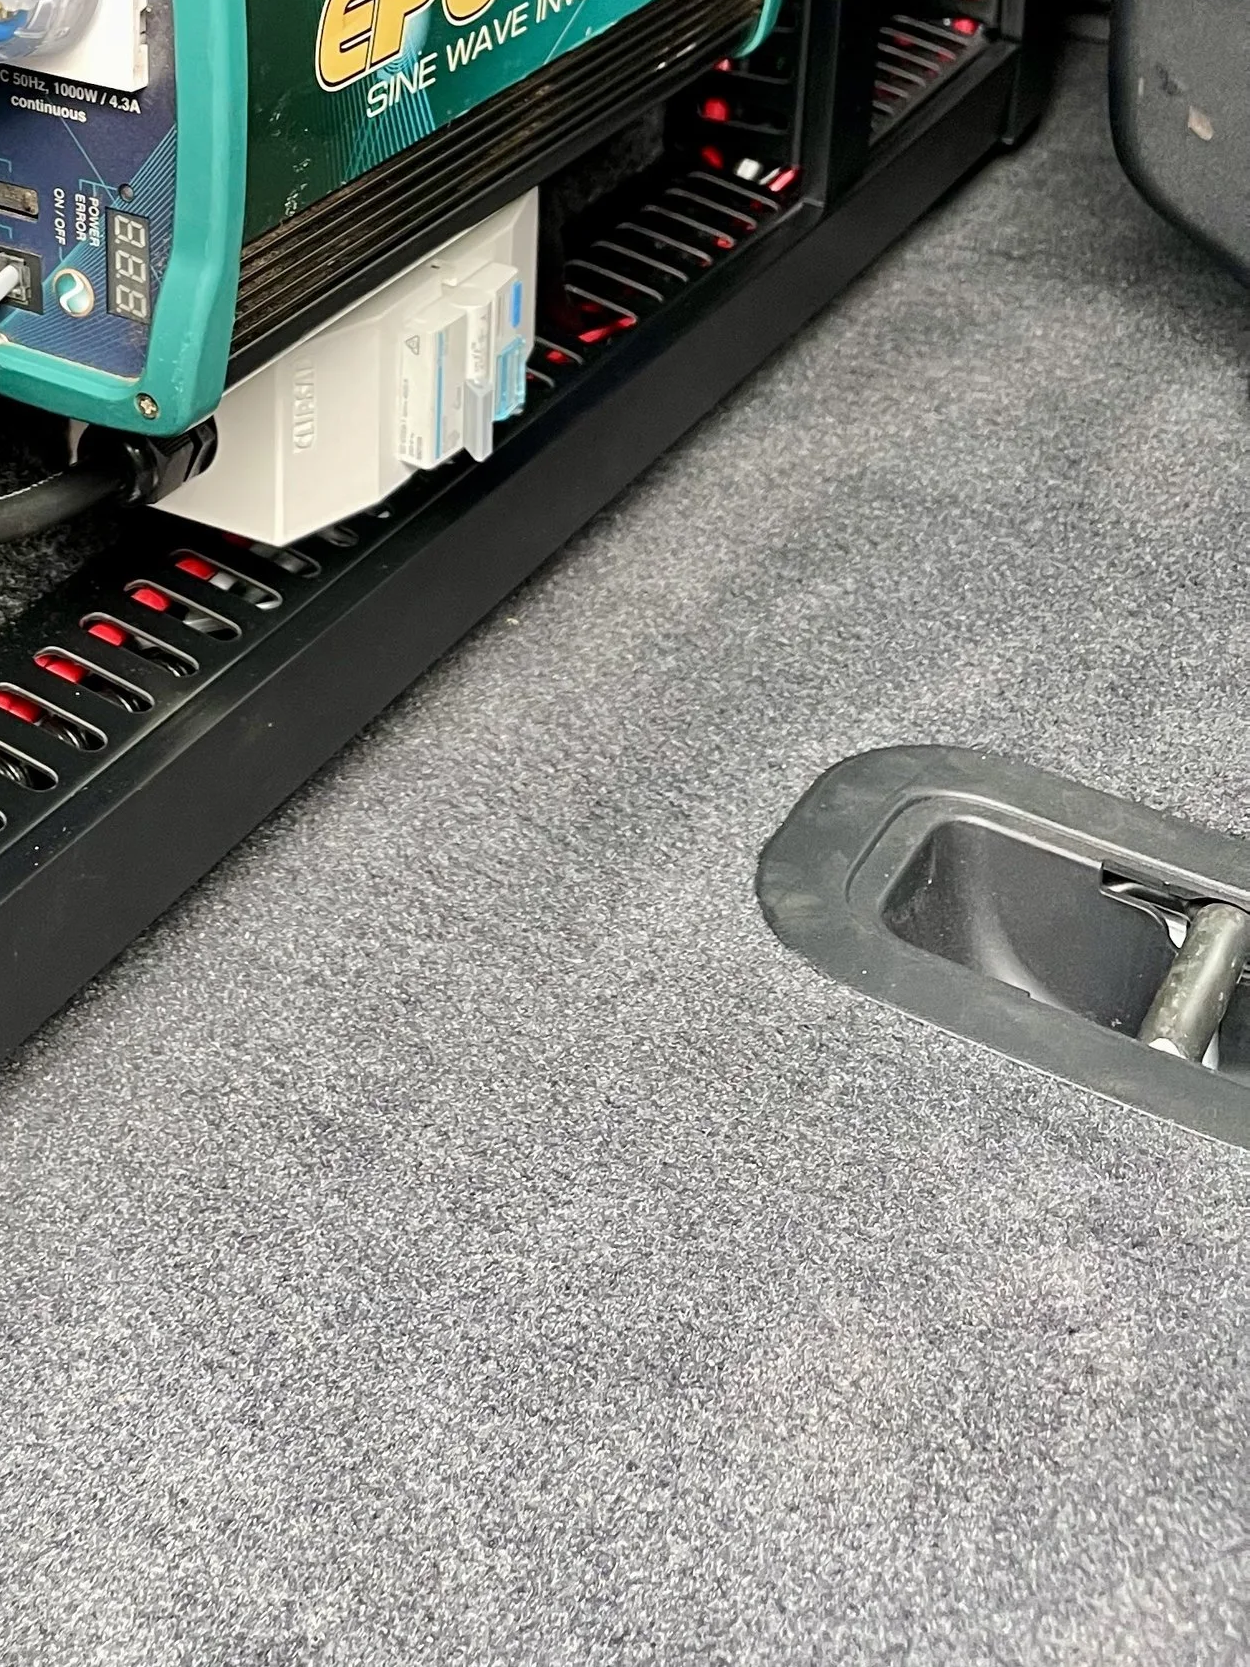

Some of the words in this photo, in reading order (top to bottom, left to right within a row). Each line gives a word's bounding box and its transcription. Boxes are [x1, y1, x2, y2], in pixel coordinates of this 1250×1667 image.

[366, 50, 438, 119] SINE
[446, 4, 529, 72] WAVE
[11, 94, 88, 124] continuous
[12, 72, 50, 95] 50Hz,
[53, 81, 99, 105] 1000W
[108, 93, 141, 115] 4.3A
[53, 188, 65, 209] ON
[75, 193, 88, 242] ERROR
[54, 218, 66, 245] OFF
[88, 196, 100, 248] POWER
